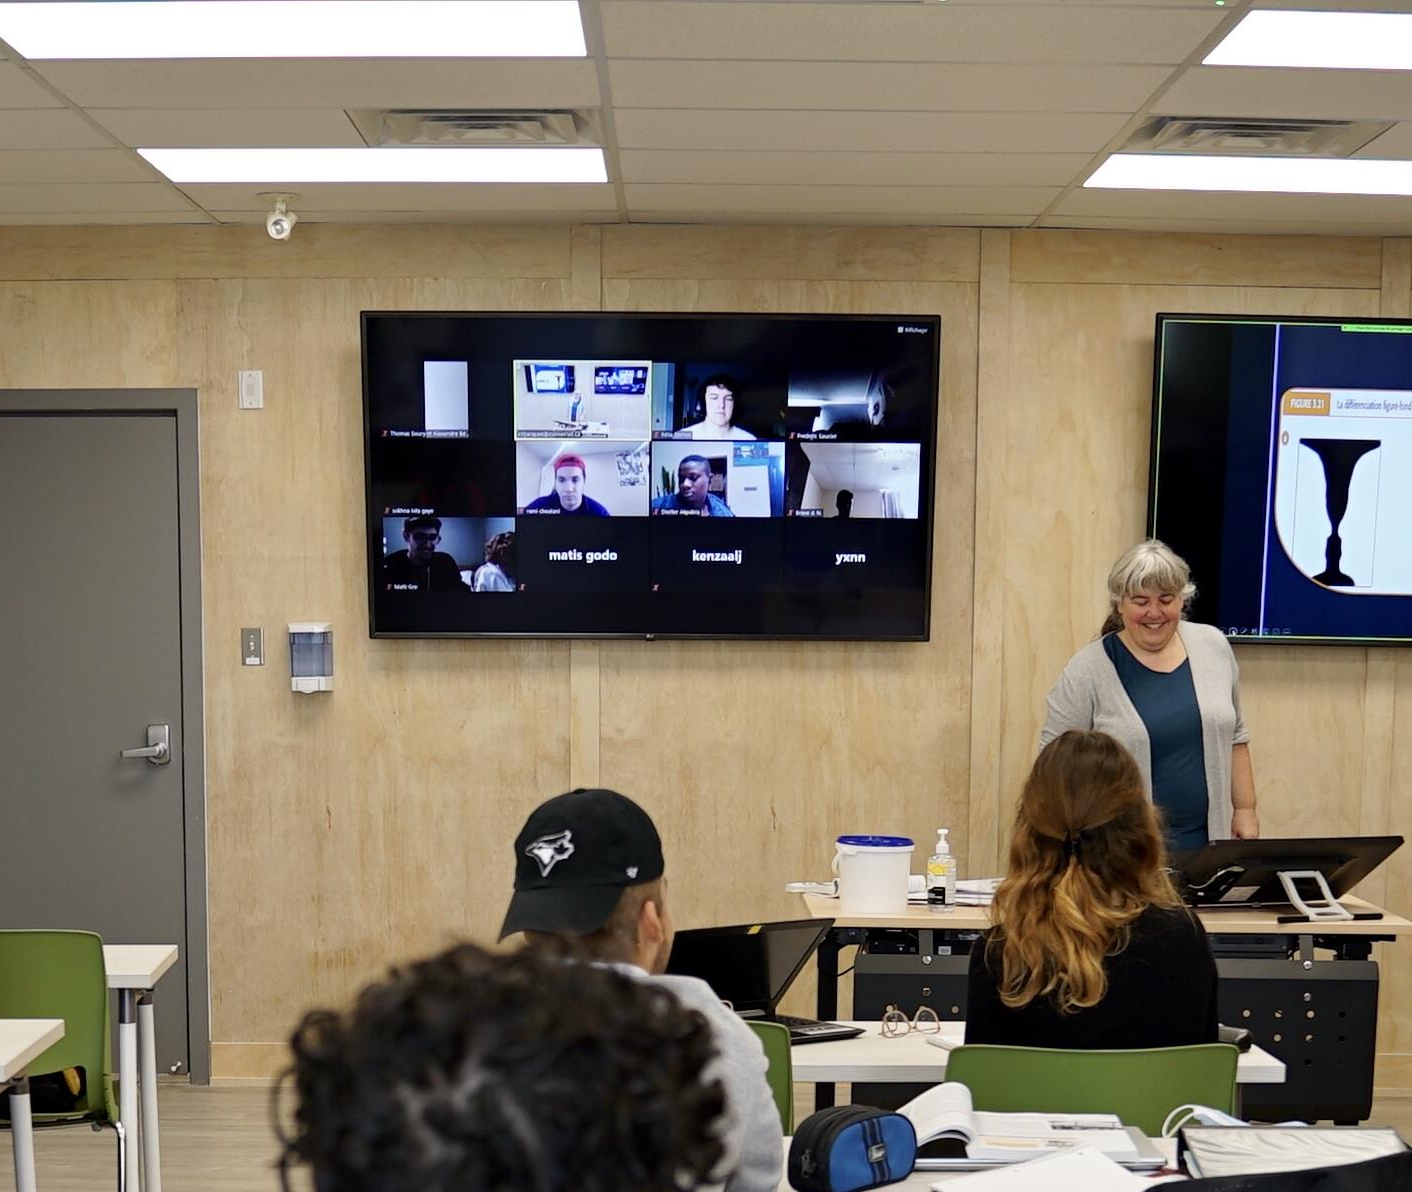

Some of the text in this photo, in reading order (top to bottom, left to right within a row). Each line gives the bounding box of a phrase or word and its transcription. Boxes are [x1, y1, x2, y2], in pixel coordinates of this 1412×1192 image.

[548, 549, 618, 563] matis godo
[692, 550, 742, 564] kenzaalj
[835, 552, 866, 565] yxnn
